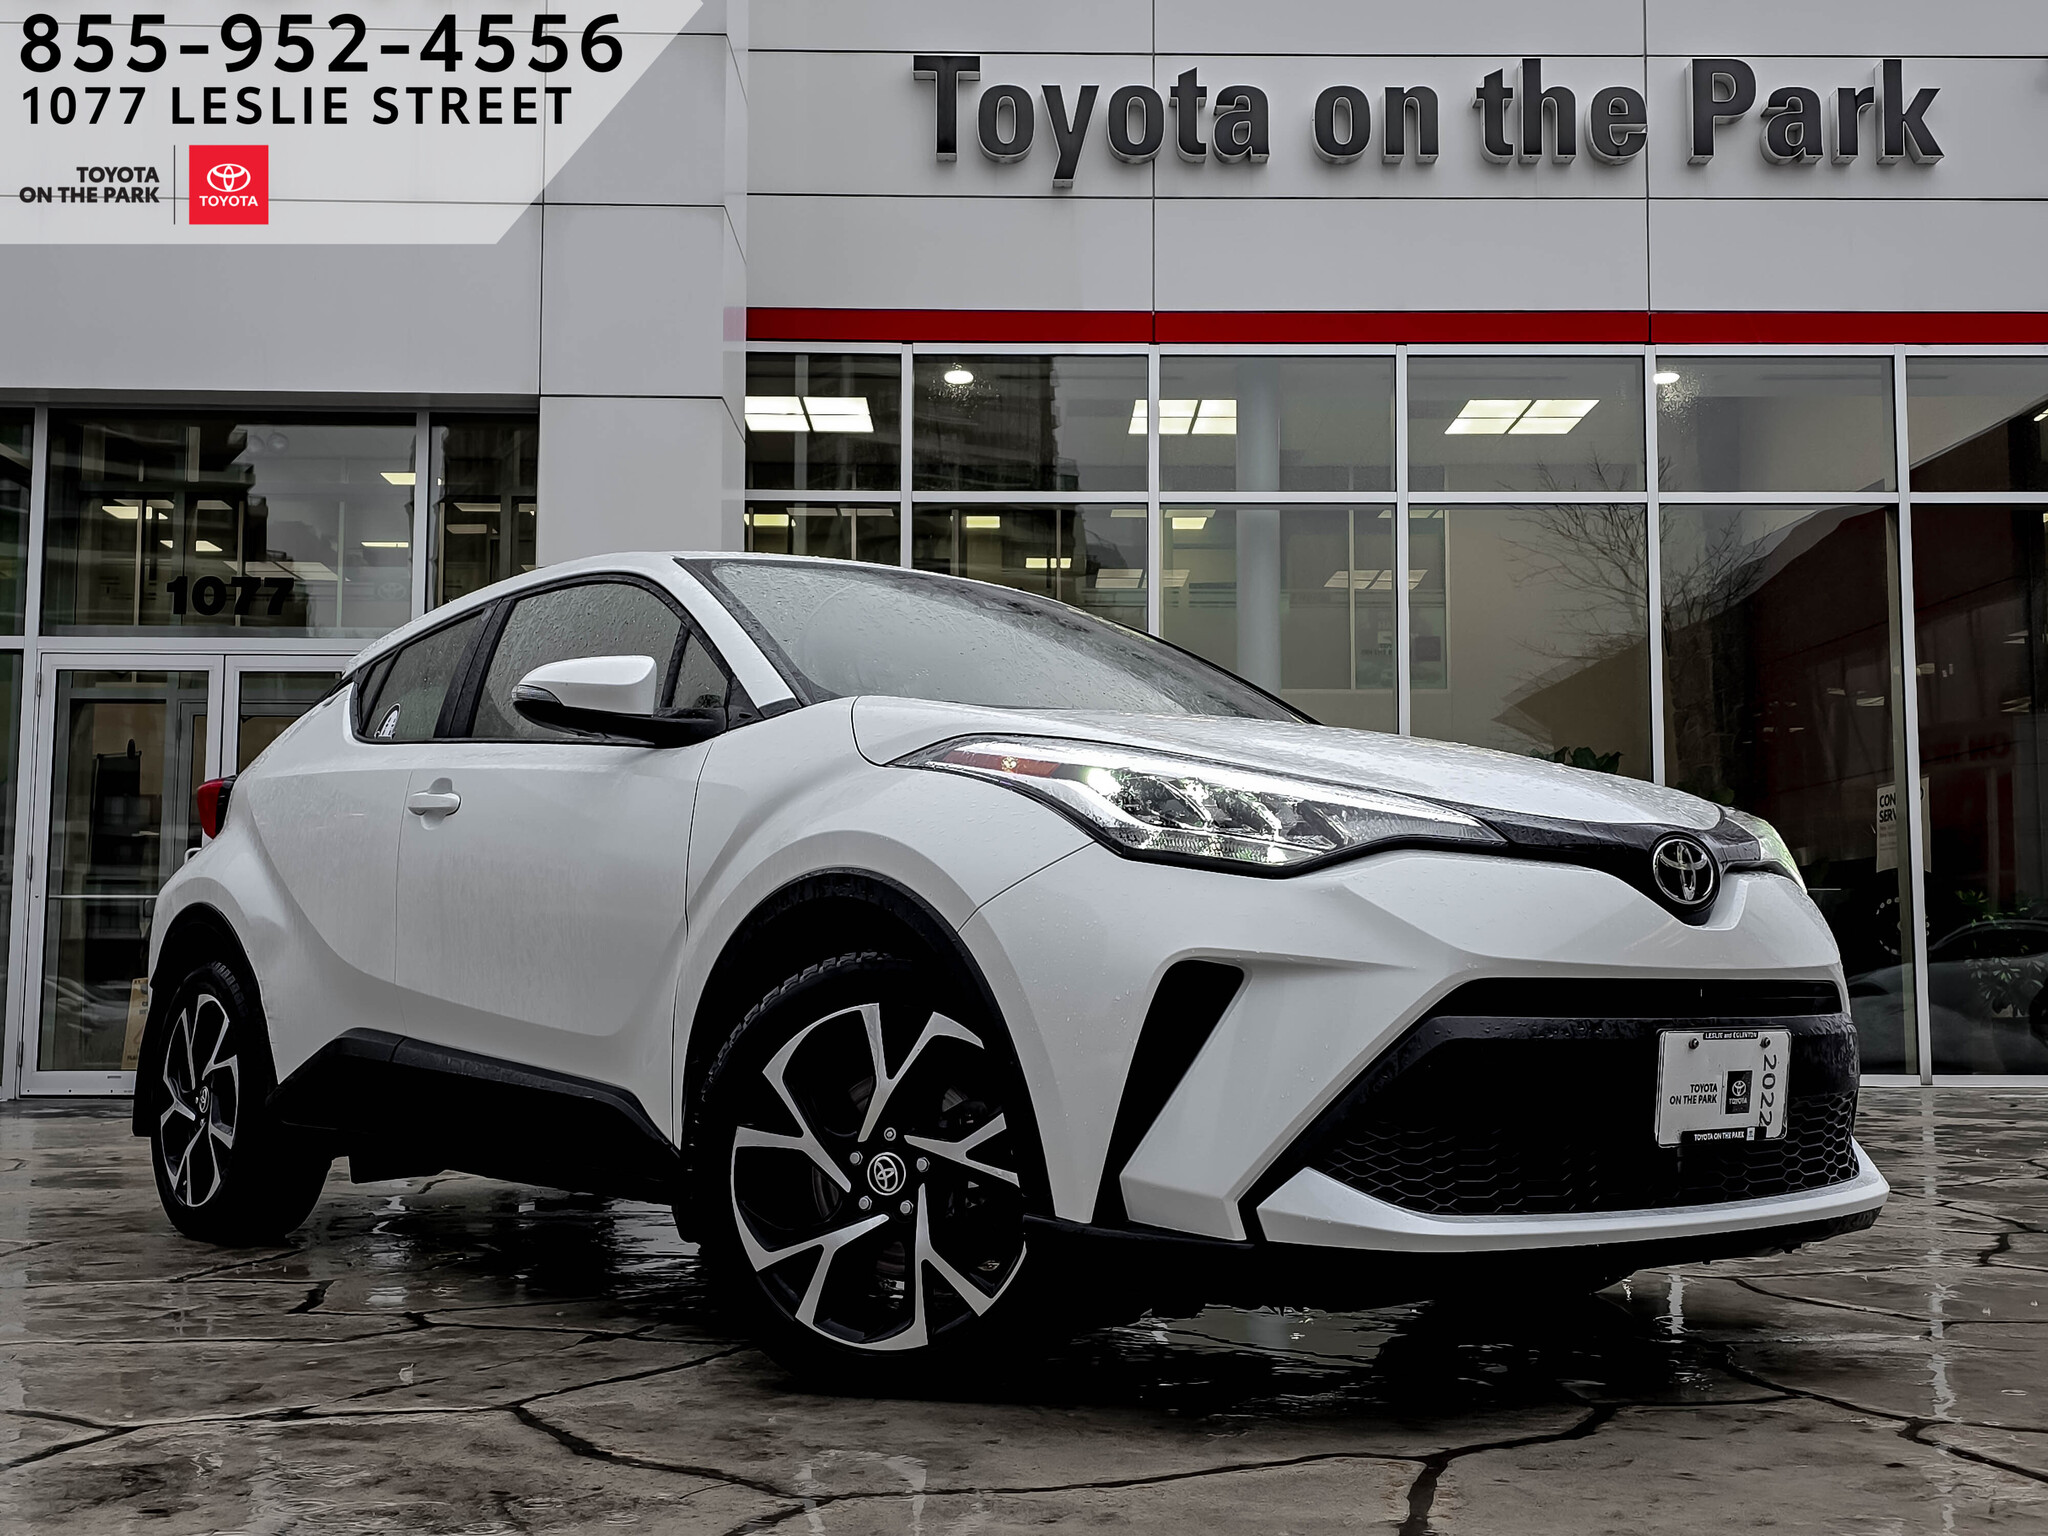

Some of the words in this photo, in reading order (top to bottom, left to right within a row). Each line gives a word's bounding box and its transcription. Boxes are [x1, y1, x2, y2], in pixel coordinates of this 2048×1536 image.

[914, 55, 1271, 188] Toyota
[1312, 84, 1440, 166] on
[1473, 57, 1648, 166] the
[1686, 57, 1945, 166] Park
[166, 575, 295, 616] 1077
[1690, 1083, 1718, 1094] TOYOTA
[1758, 1054, 1777, 1127] 2022
[1669, 1095, 1682, 1105] ON
[1683, 1095, 1697, 1105] THE
[1698, 1094, 1718, 1105] PARK
[1728, 1097, 1748, 1105] TOYOTA
[1694, 1132, 1713, 1141] TOYOTA
[1714, 1132, 1722, 1140] ON
[1722, 1131, 1731, 1140] THE
[1732, 1131, 1745, 1139] PARK
